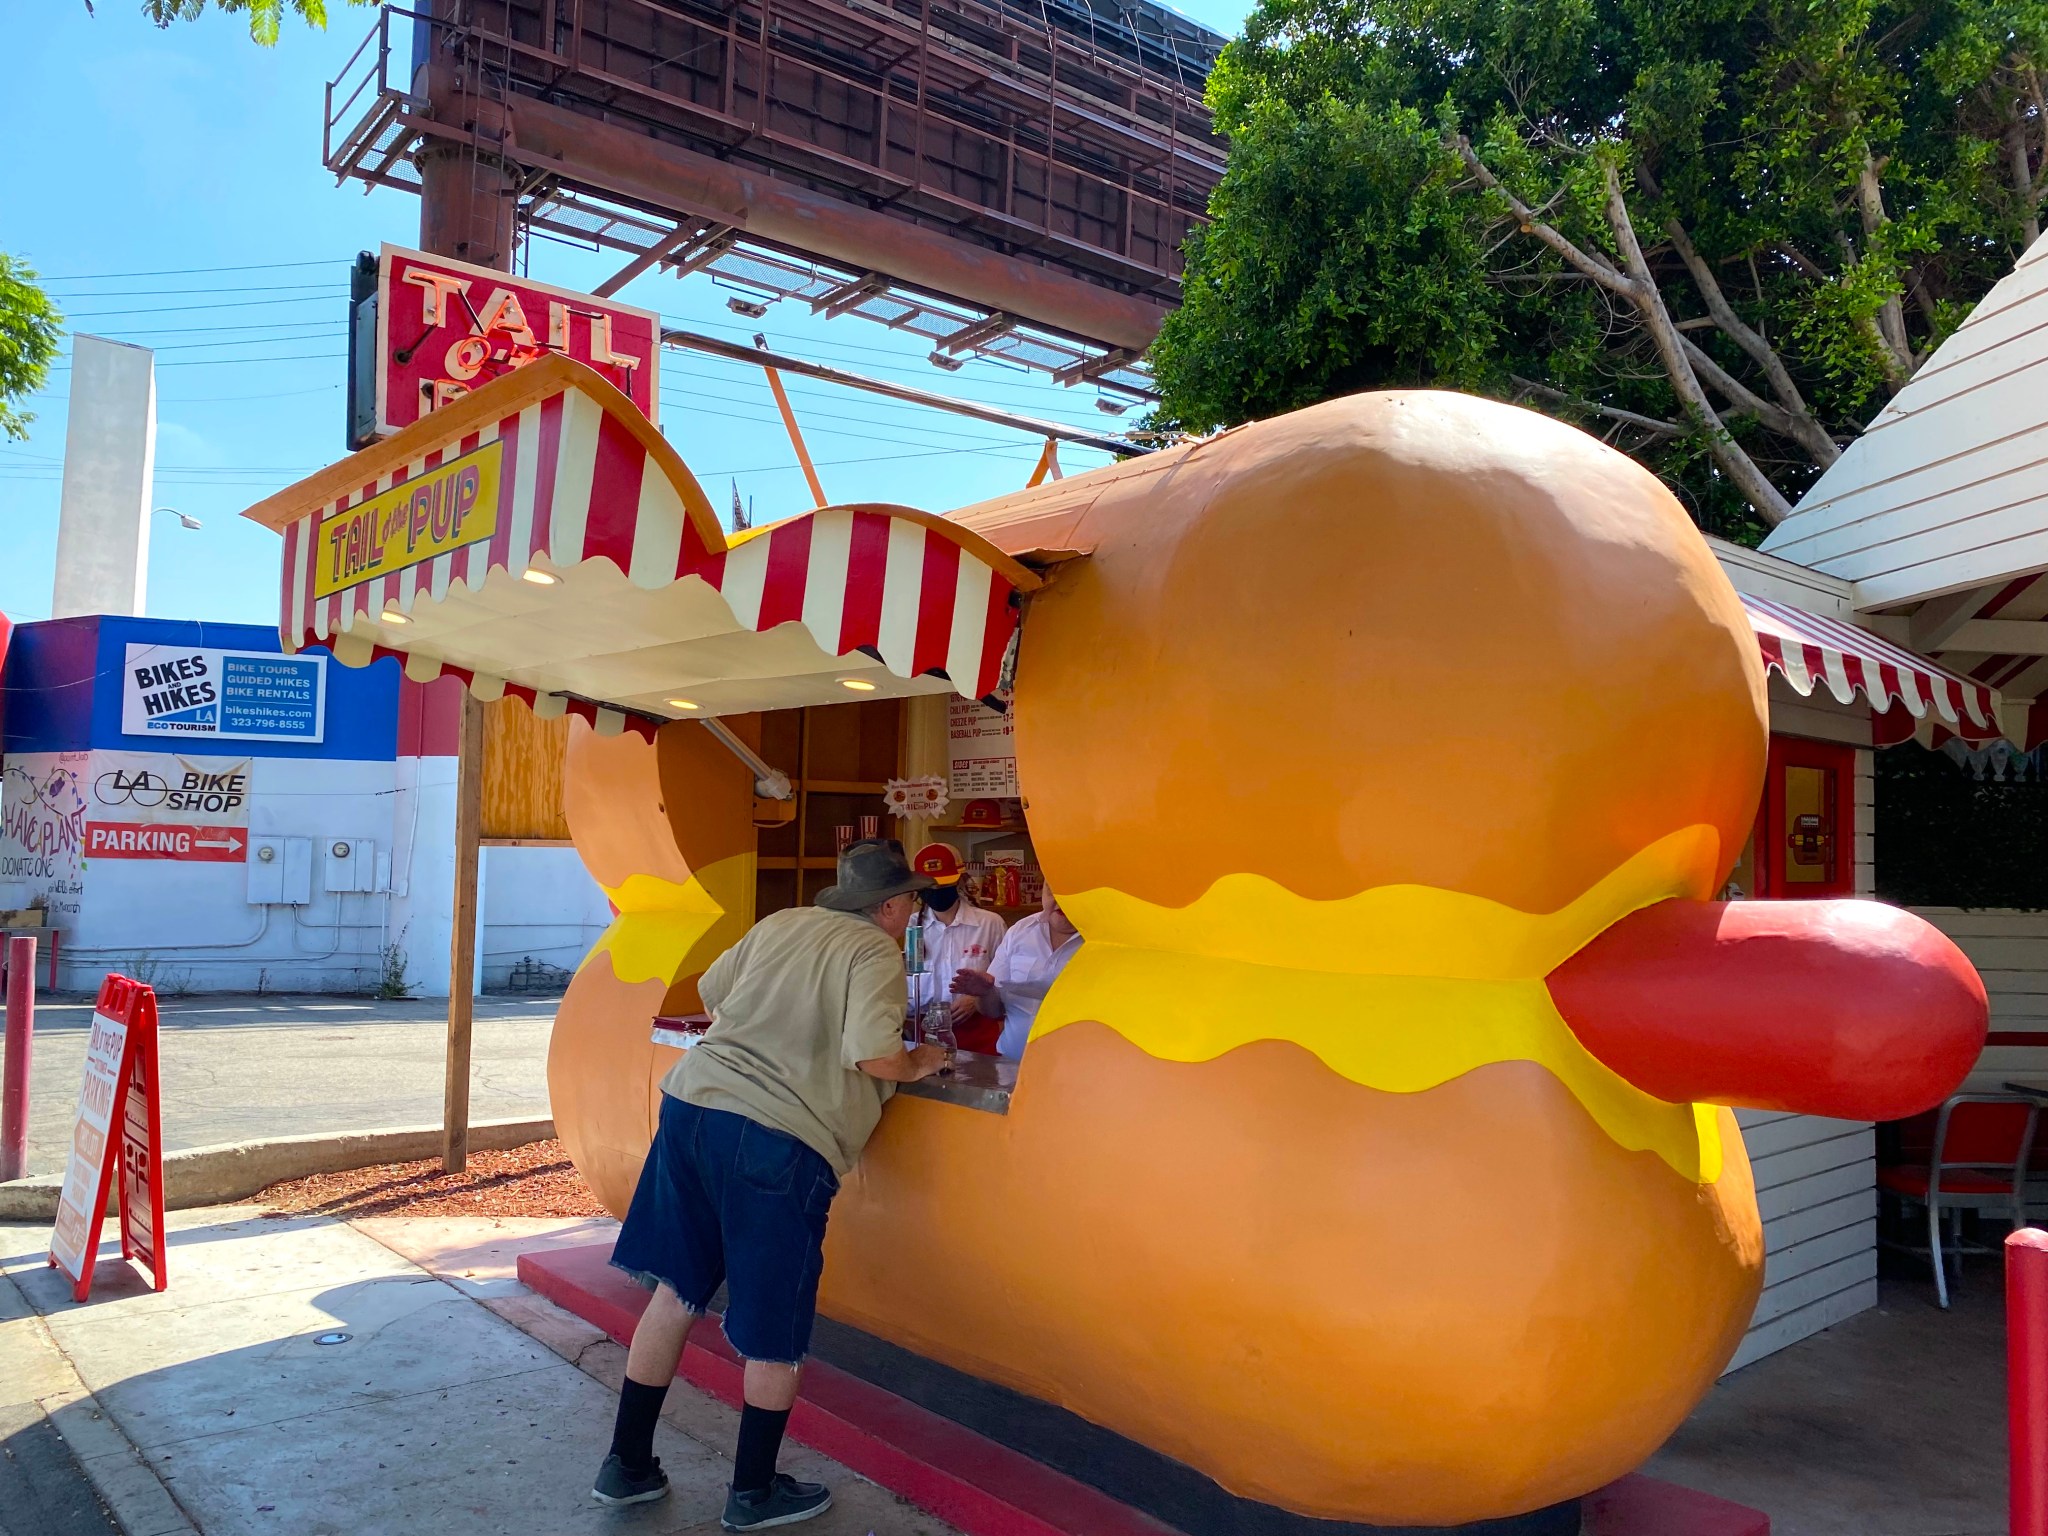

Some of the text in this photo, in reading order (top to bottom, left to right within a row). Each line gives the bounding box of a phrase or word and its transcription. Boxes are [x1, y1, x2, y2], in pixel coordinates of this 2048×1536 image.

[402, 265, 641, 371] TAIL
[331, 508, 385, 583] TAIL
[407, 465, 480, 554] PUP
[134, 655, 208, 690] BIKES
[227, 663, 298, 675] BIKE TOURS
[168, 682, 182, 690] AND
[227, 675, 311, 688] GUIDED HIKES
[142, 681, 216, 716] HIKES
[226, 687, 310, 700] BIKE RENTALS
[195, 709, 215, 722] LA
[225, 705, 312, 718] bikeshikes.com
[961, 704, 970, 714] PUP
[231, 718, 306, 730] 323-796-8555
[967, 716, 977, 726] PUP
[950, 729, 972, 740] BASEBALL
[972, 728, 982, 738] PUP
[113, 769, 151, 790] LA
[181, 772, 246, 793] BIKE
[167, 792, 242, 813] SHOP
[4, 802, 38, 853] HAVE
[41, 804, 87, 859] PLANT
[91, 829, 190, 853] PARKING
[2, 857, 55, 878] DONATE ONE
[109, 1031, 123, 1062] PUP
[83, 1069, 112, 1121] PARKING
